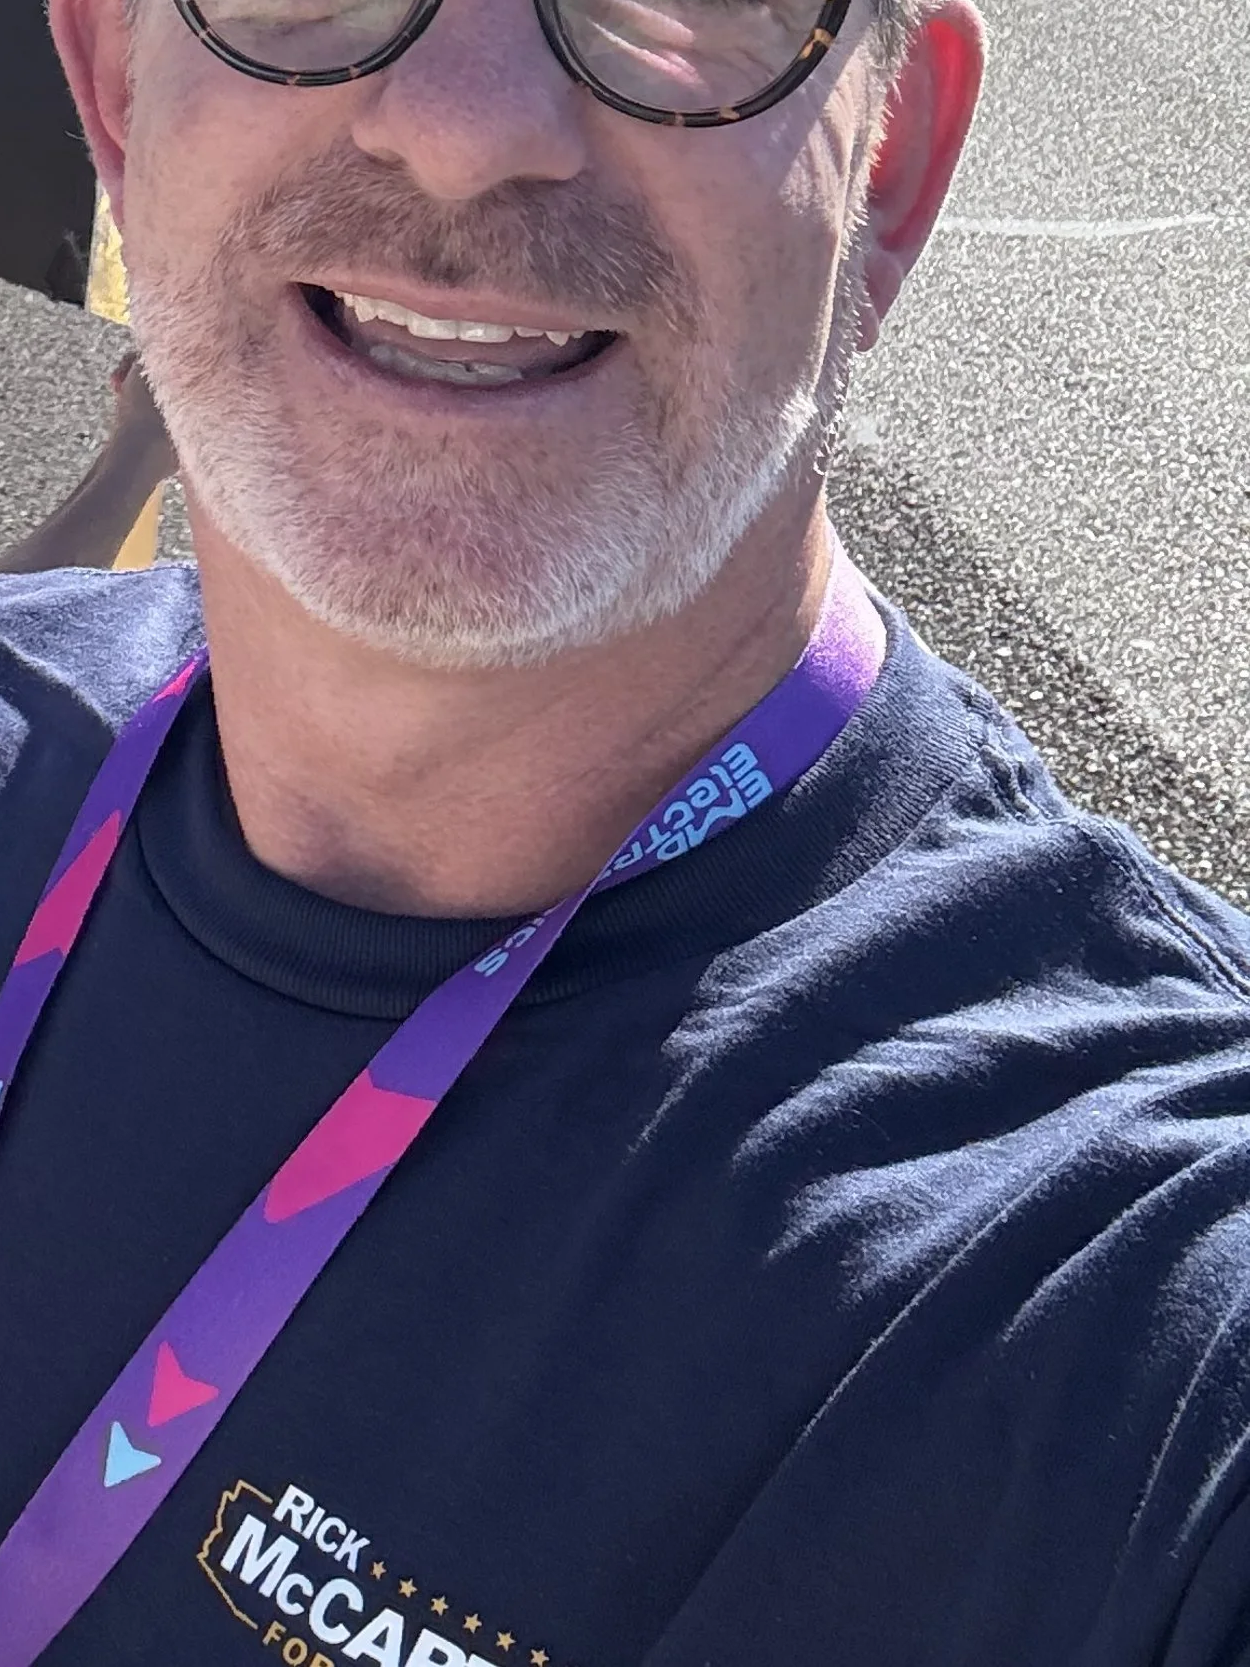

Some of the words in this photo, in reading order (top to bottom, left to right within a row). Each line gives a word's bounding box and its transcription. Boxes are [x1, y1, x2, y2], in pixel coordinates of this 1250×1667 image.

[656, 769, 772, 861] EMD
[272, 1484, 370, 1573] RICK
[220, 1513, 502, 1667] McCAR
